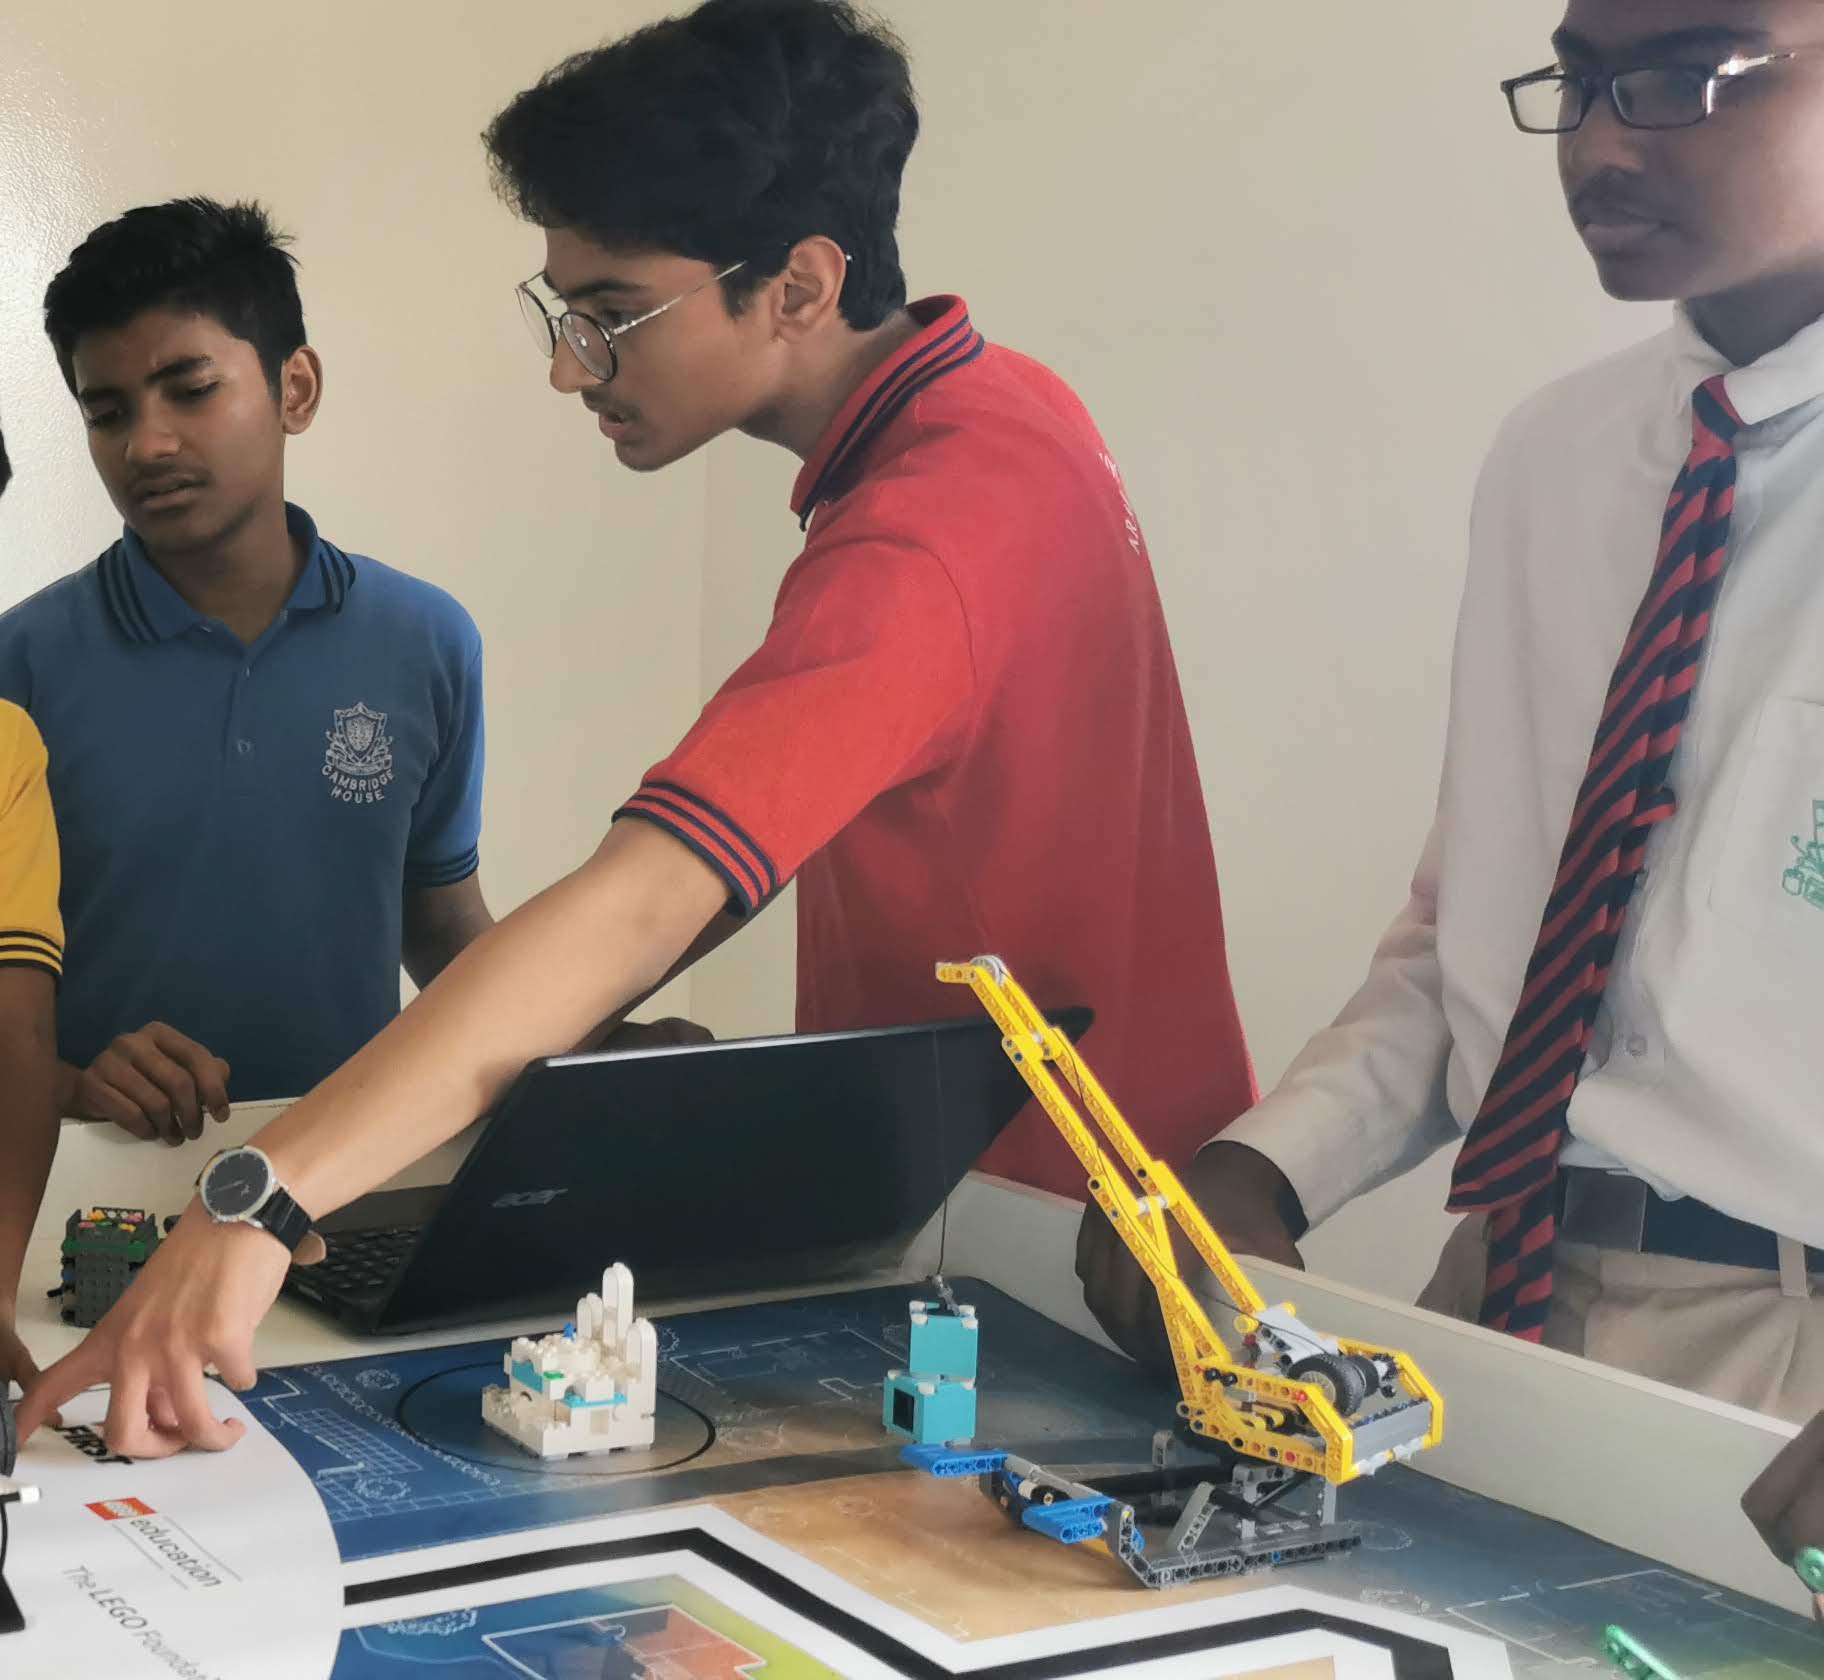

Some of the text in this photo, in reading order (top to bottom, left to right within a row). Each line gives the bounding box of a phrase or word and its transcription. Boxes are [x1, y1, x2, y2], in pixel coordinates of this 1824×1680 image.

[321, 764, 394, 791] CAMBRIDGE
[331, 785, 385, 804] HOUSE
[129, 1518, 222, 1588] education
[62, 1565, 97, 1589] The
[89, 1588, 148, 1630] LEGO
